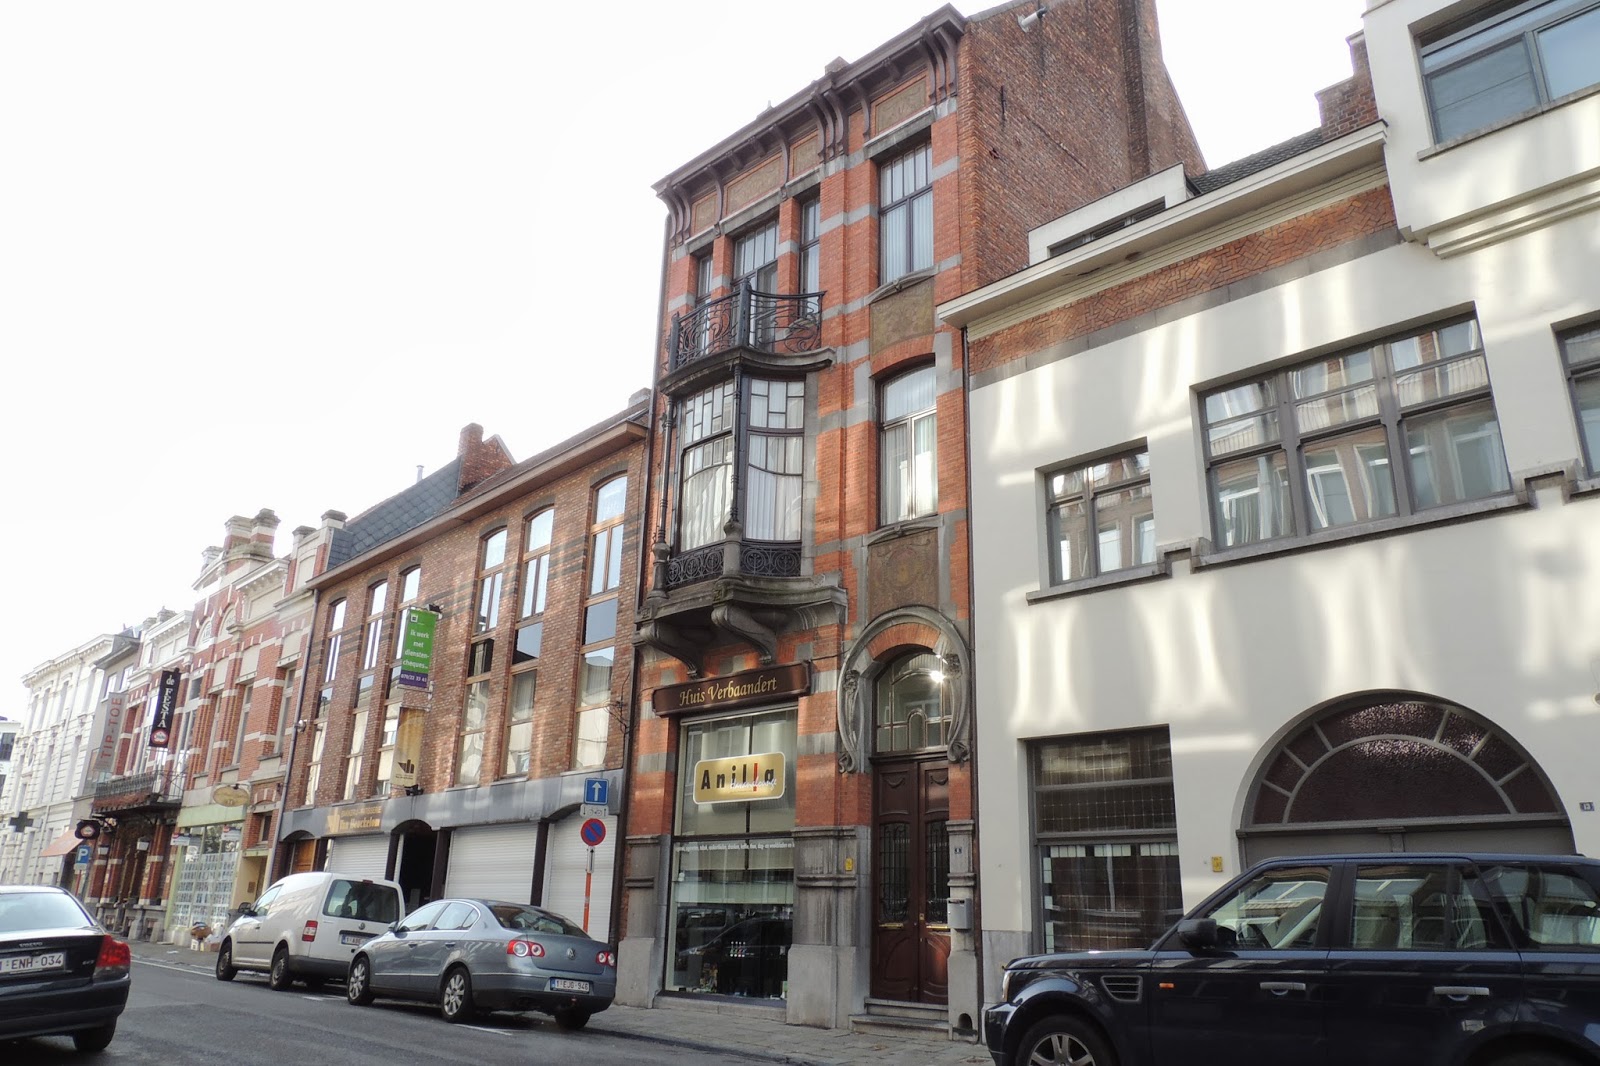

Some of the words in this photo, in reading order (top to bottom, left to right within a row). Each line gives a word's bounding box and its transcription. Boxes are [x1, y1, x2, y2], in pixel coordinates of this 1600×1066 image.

[416, 631, 430, 639] werk
[413, 640, 424, 648] met
[404, 649, 430, 659] diensten-
[165, 674, 175, 686] de
[679, 688, 706, 707] Huis
[707, 674, 777, 701] Verbaandert
[157, 687, 174, 728] FESTA
[101, 697, 122, 759] TIP-TOE
